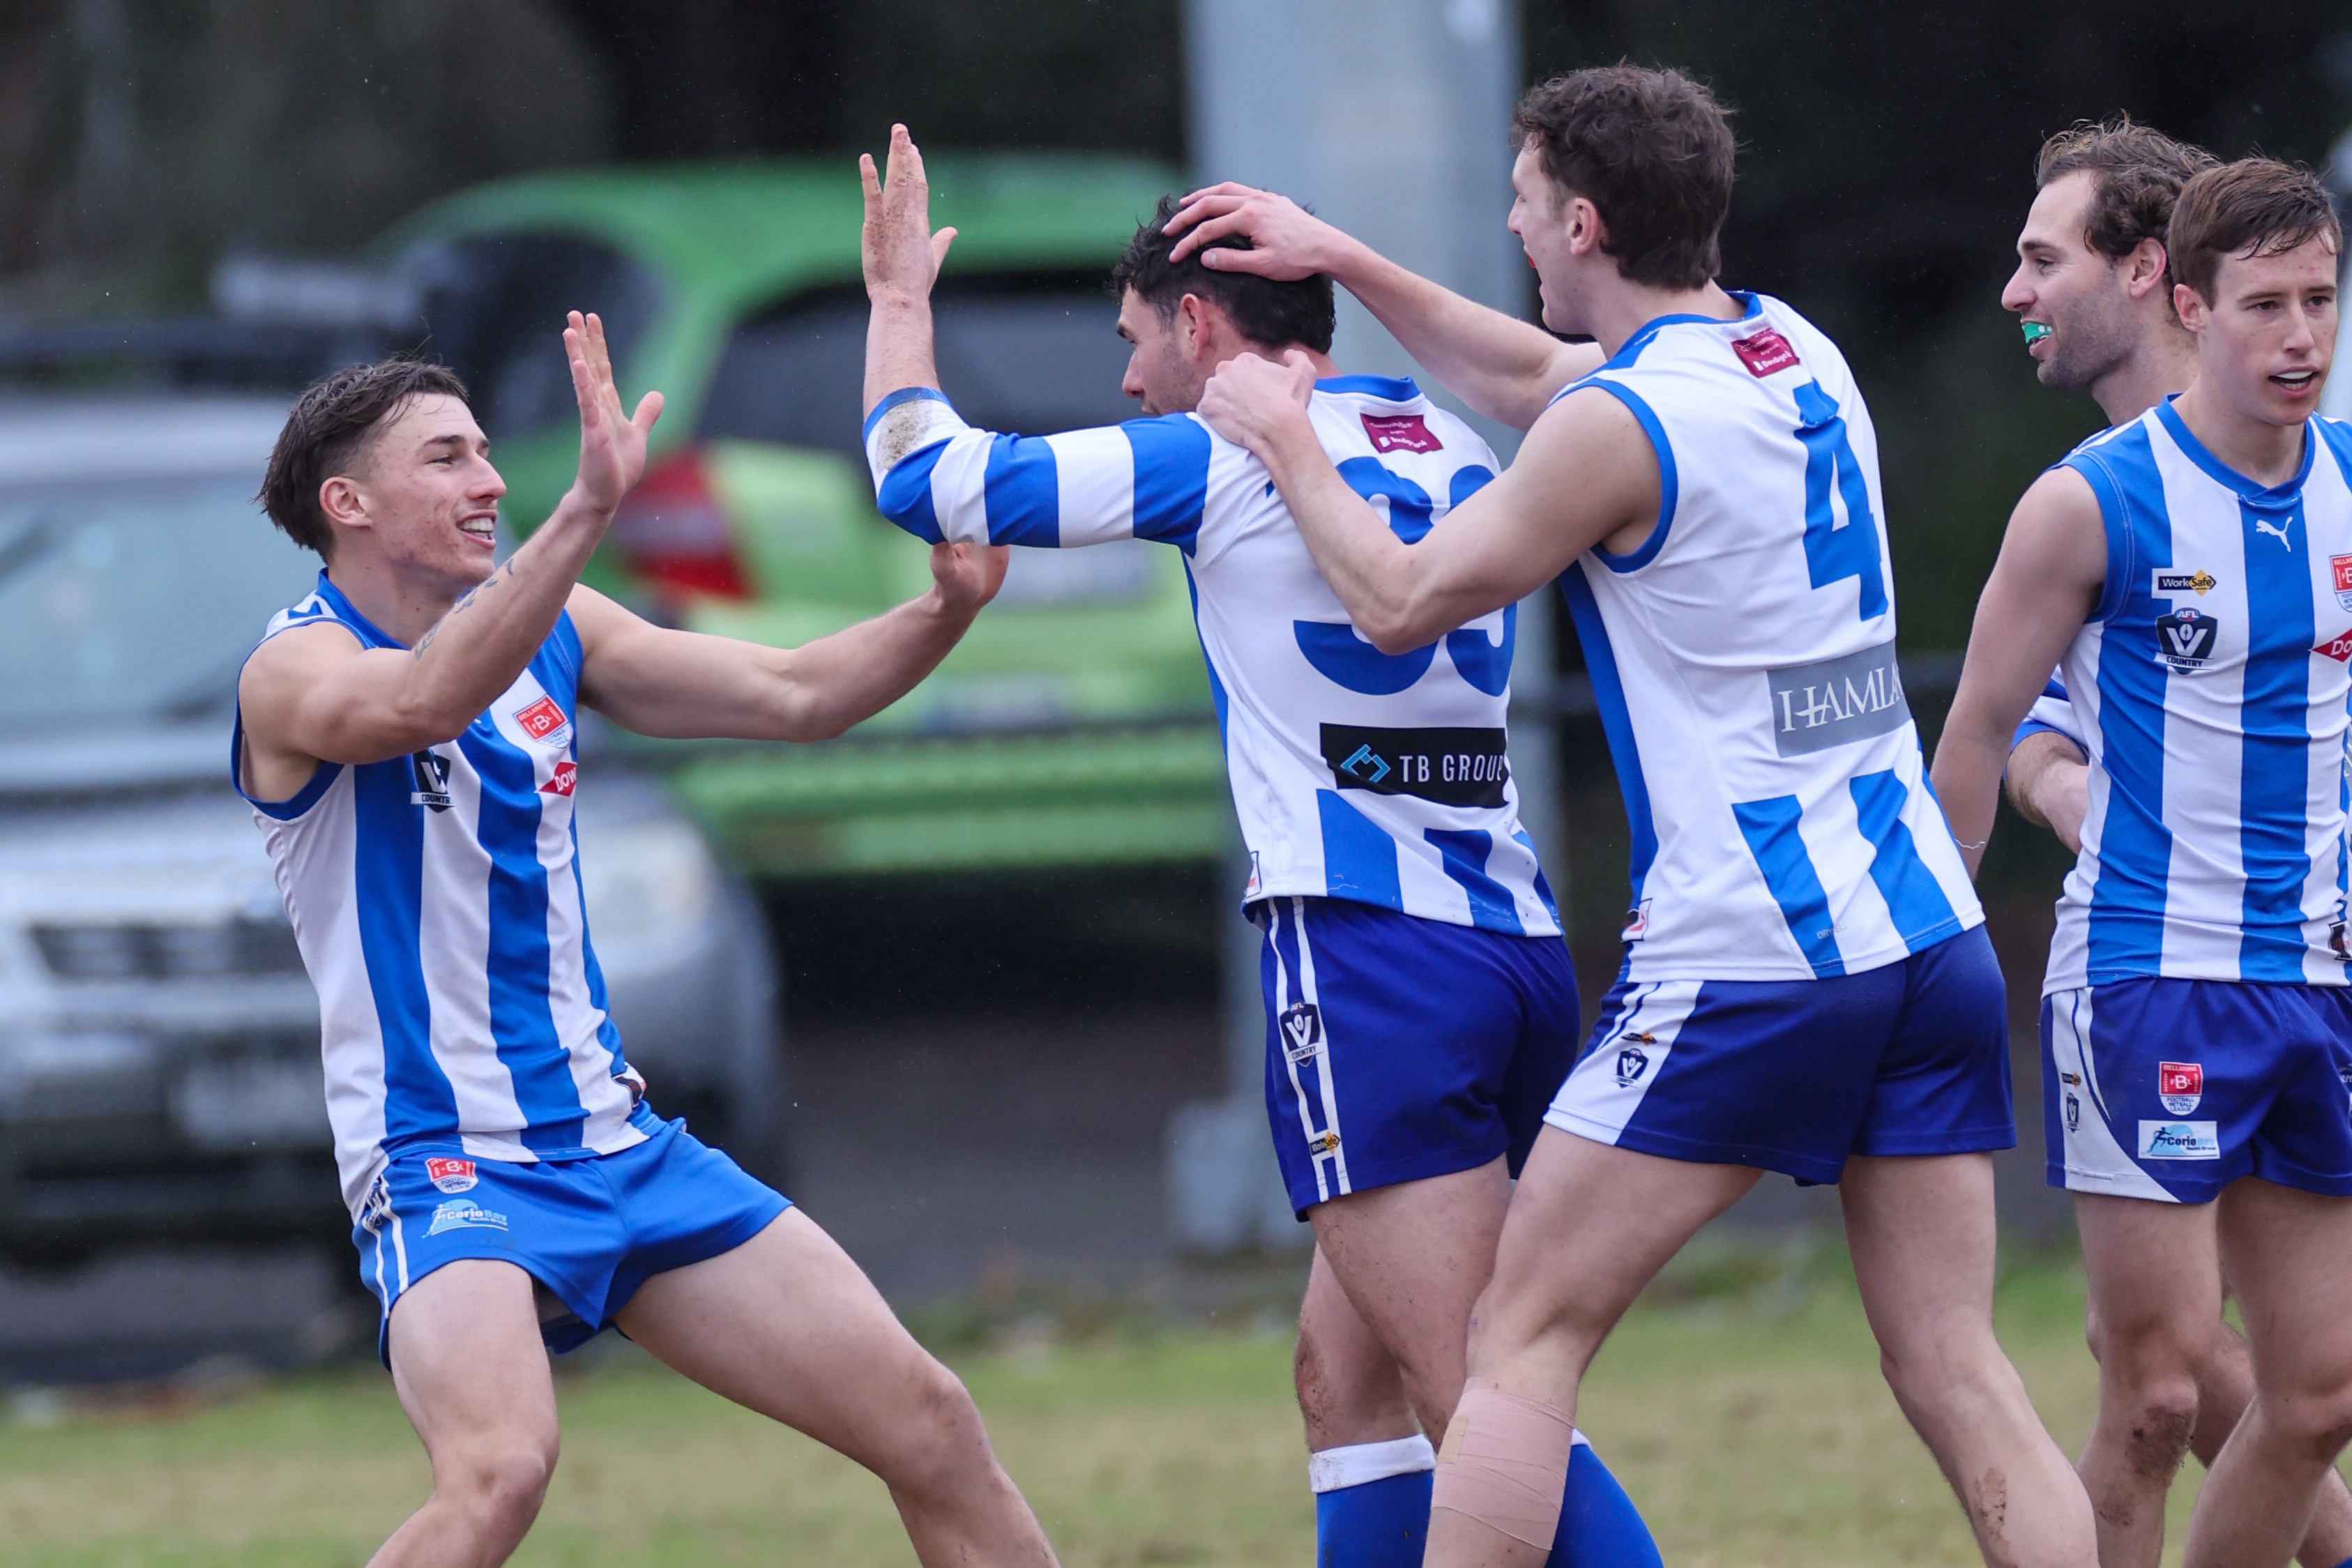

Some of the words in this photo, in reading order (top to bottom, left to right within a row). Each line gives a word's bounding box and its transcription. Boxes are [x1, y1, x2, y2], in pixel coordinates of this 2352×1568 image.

[1793, 376, 1888, 622] 4
[2162, 578, 2212, 587] WorkSafe
[2176, 610, 2199, 619] AFL
[2167, 655, 2203, 667] COUNTRY
[517, 699, 549, 721] BELLARINE
[1399, 754, 1429, 783] TB
[554, 766, 577, 793] DOW
[421, 793, 451, 805] COUNTR
[1291, 1002, 1304, 1012] AFL
[1292, 1045, 1316, 1060] COUNTRY
